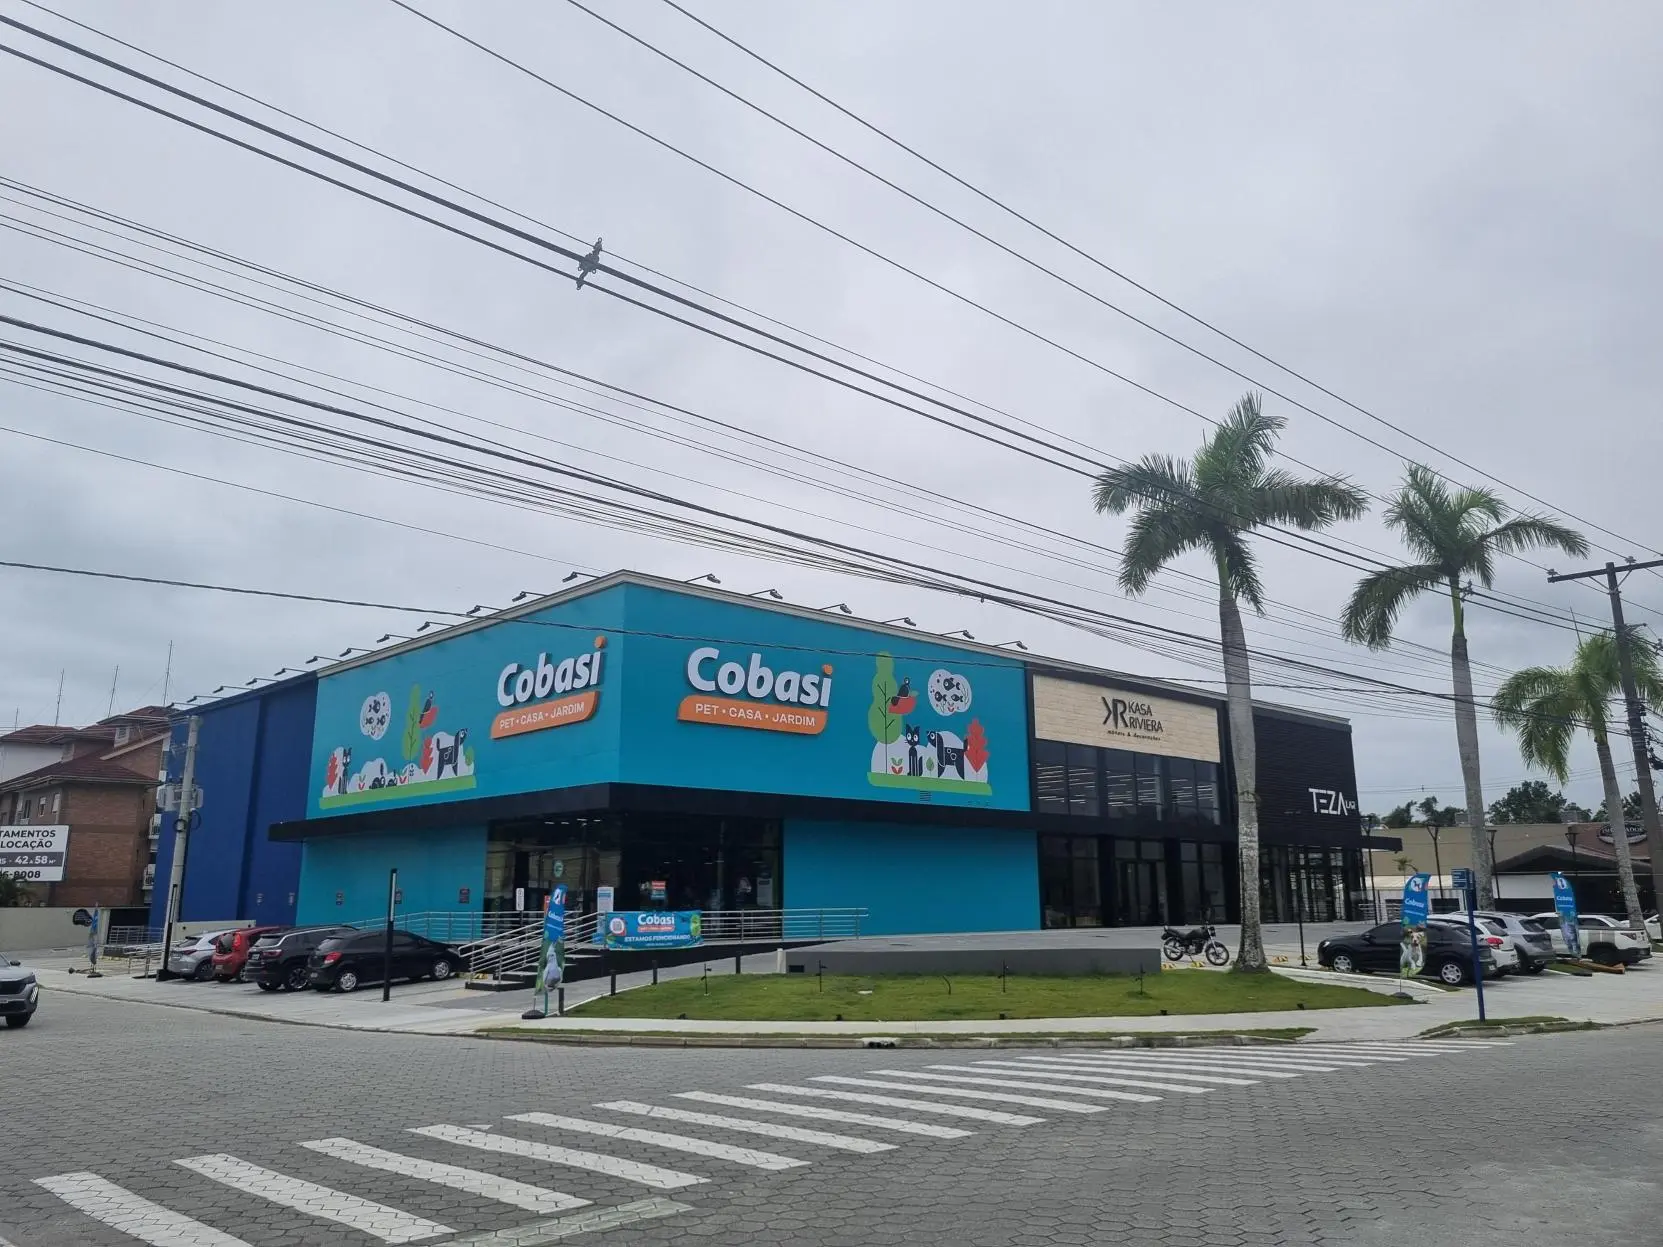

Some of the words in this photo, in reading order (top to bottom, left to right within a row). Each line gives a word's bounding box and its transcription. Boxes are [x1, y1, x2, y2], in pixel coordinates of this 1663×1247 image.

[497, 635, 606, 707] Cobasi
[687, 646, 834, 707] Cobasi
[500, 717, 515, 730] PET
[520, 711, 544, 725] CASA
[551, 702, 585, 718] JARDIM
[695, 703, 719, 715] PET
[729, 707, 763, 721] CASA
[772, 712, 816, 727] JARDIM
[1128, 702, 1153, 716] KASA
[1129, 717, 1164, 732] RIVIERA
[1308, 788, 1348, 816] TEZA
[0, 838, 53, 850] LOCAÇÃO
[15, 855, 29, 865] 42
[34, 855, 48, 865] 58
[637, 913, 675, 925] Cobasi
